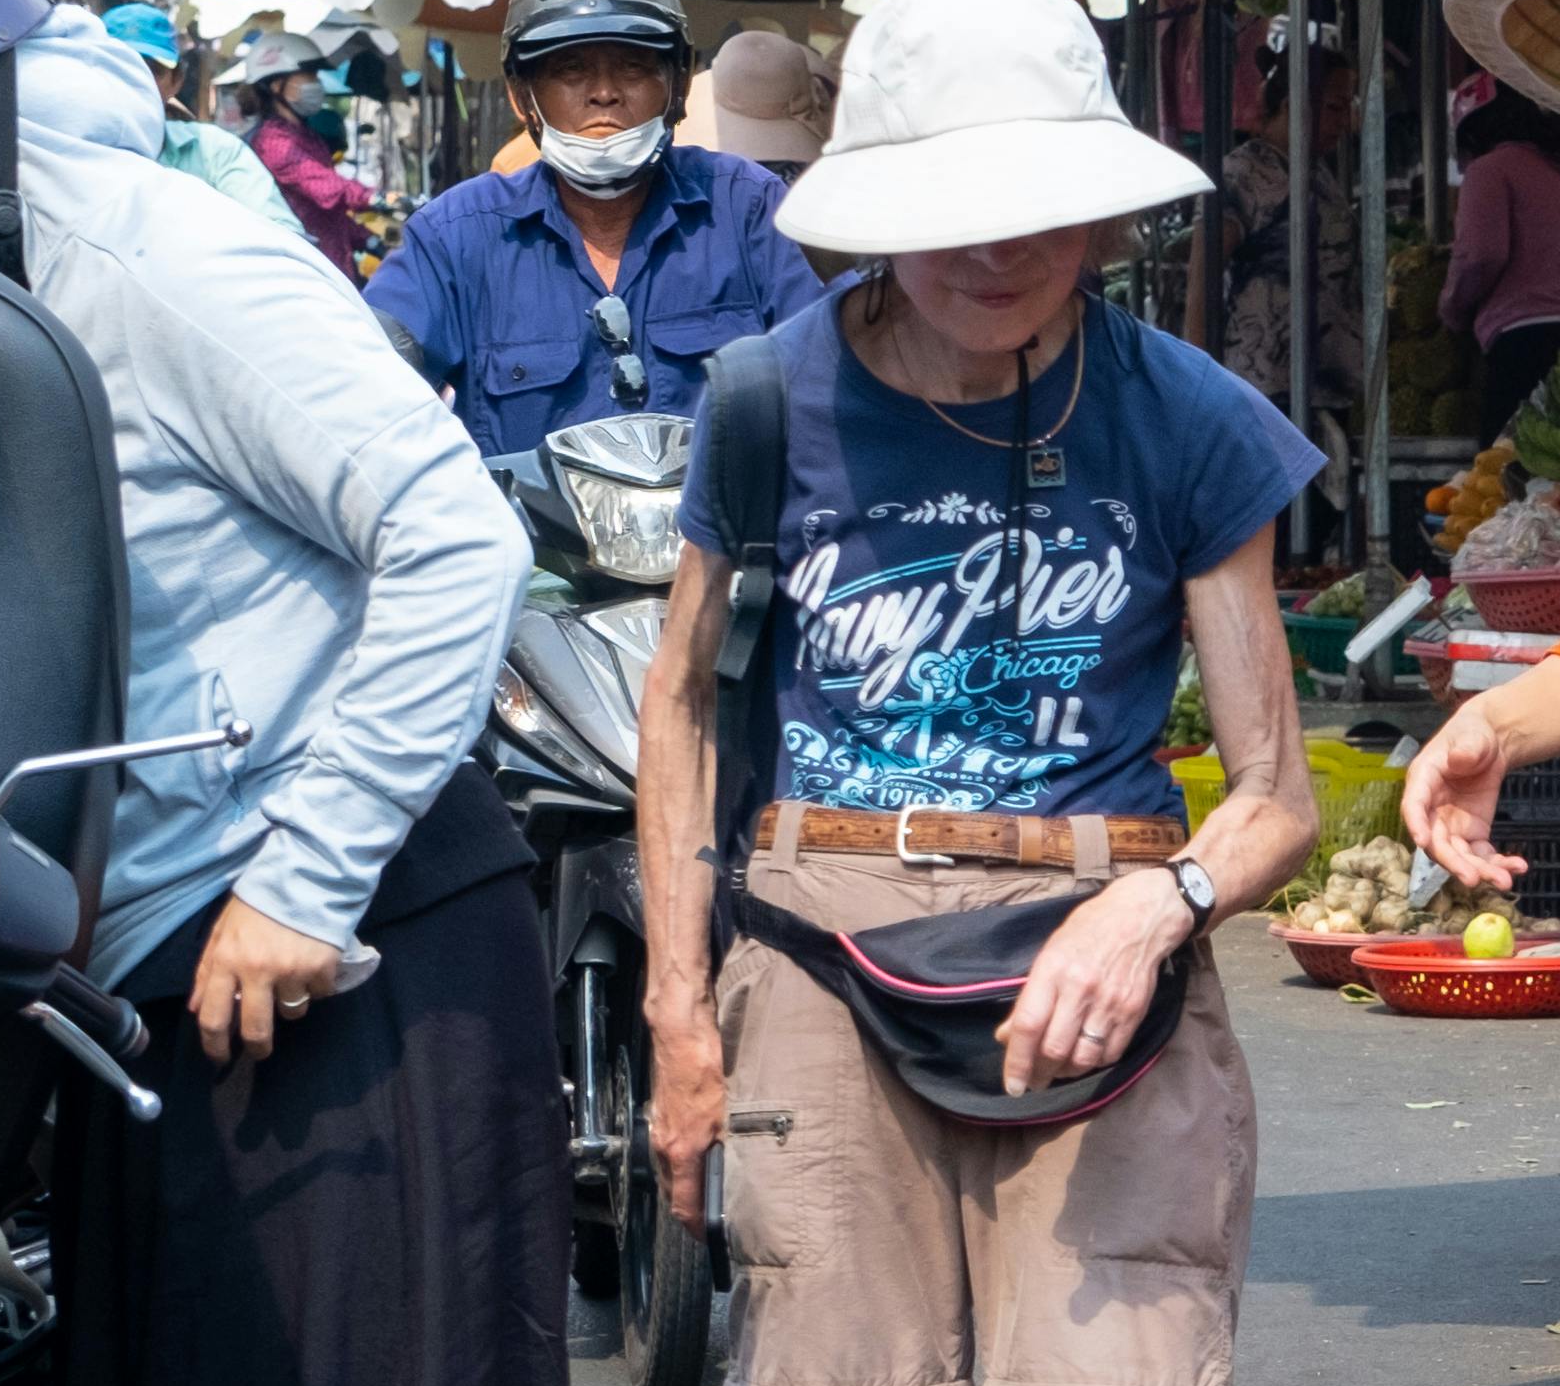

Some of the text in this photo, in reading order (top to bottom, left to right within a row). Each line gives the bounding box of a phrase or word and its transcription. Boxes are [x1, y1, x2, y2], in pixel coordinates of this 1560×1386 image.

[788, 526, 1132, 711] Navy Pier
[961, 642, 1104, 689] Chicago
[1034, 696, 1090, 748] IL
[877, 787, 929, 807] 1916
